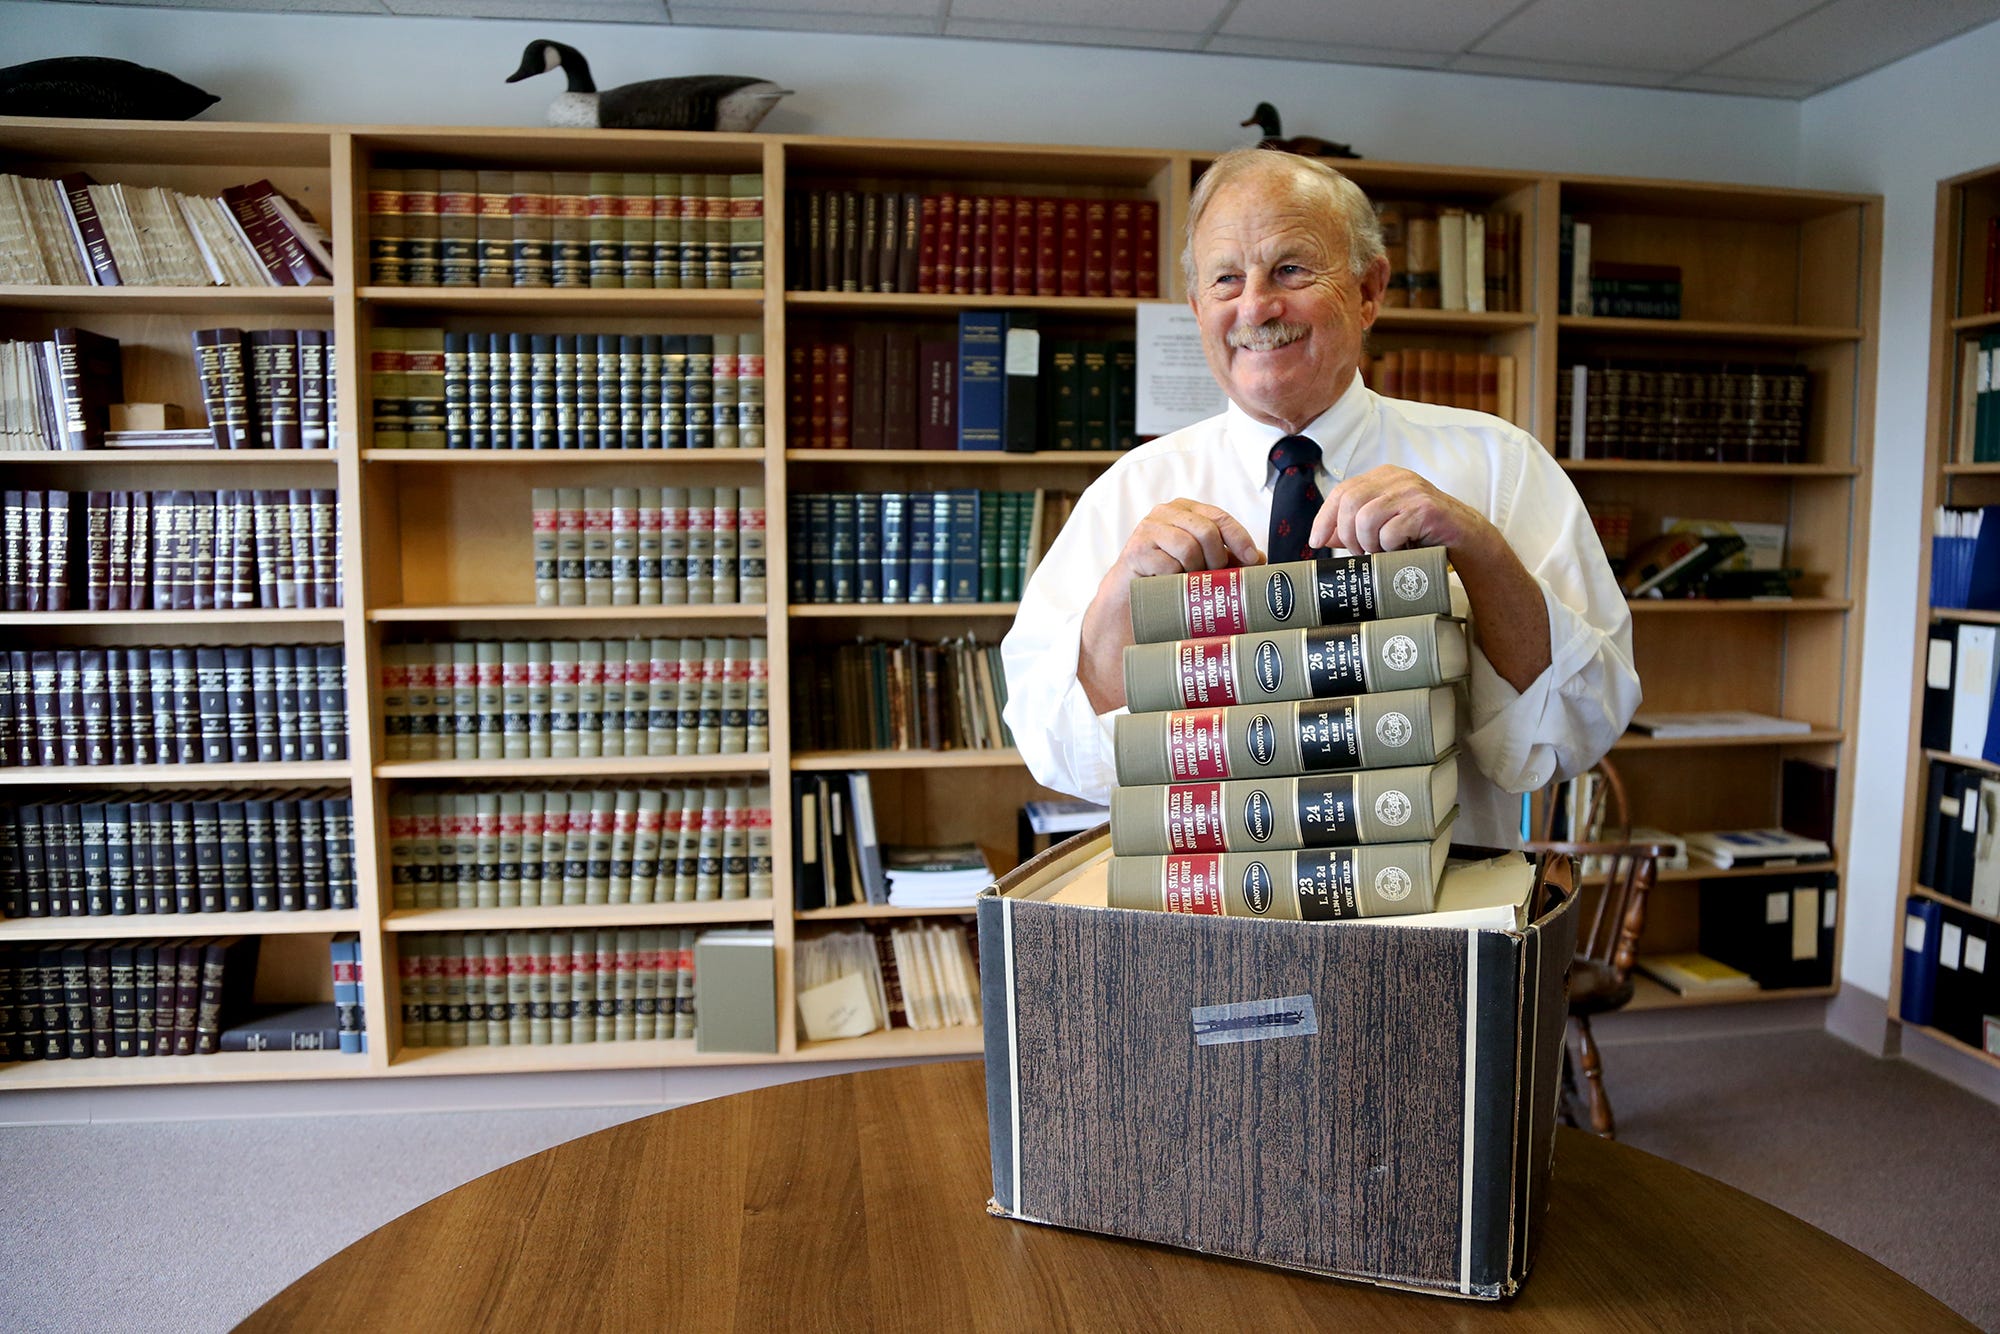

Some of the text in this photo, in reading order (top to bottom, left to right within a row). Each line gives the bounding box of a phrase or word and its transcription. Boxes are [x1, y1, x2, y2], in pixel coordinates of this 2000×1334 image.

[1190, 576, 1202, 632] UNITED STATES
[1202, 574, 1216, 632] SUPREME COURT
[1215, 586, 1226, 618] REPORTS
[1273, 573, 1284, 616] ANNOTATED
[1320, 582, 1334, 598] 27
[1336, 569, 1348, 608] L. Ed. 2d
[1362, 562, 1373, 610] COURT RULES
[1183, 648, 1196, 702] UNITED STATES
[1194, 646, 1208, 702] SUPREME COURT
[1207, 657, 1218, 688] REPORTS
[1264, 645, 1274, 688] ANNOTATED
[1309, 653, 1323, 670] 26
[1326, 640, 1338, 680] L. Ed. 2d
[1352, 634, 1362, 681] COURT RULES
[1174, 718, 1186, 774] UNITED STATES
[1185, 716, 1199, 776] SUPREME COURT
[1197, 728, 1208, 760] REPORTS
[1256, 718, 1266, 760] ANNOTATED
[1302, 725, 1316, 742] 25
[1319, 713, 1330, 752] L. Ed. 2d
[1345, 707, 1356, 755] COURT RULES
[1171, 793, 1184, 848] UNITED STATES
[1183, 791, 1197, 849] SUPREME COURT
[1196, 804, 1207, 835] REPORTS
[1254, 794, 1264, 838] ANNOTATED
[1306, 805, 1321, 823] 24
[1323, 792, 1336, 832] L. Ed. 2d
[1169, 863, 1178, 888] STATES
[1181, 861, 1193, 914] UPREME COURT
[1194, 874, 1204, 905] REPORTS
[1252, 866, 1262, 910] ANNOTATED
[1299, 878, 1314, 895] 23
[1317, 865, 1328, 905] L. Ed. 2d
[1343, 860, 1354, 907] COURT RULES
